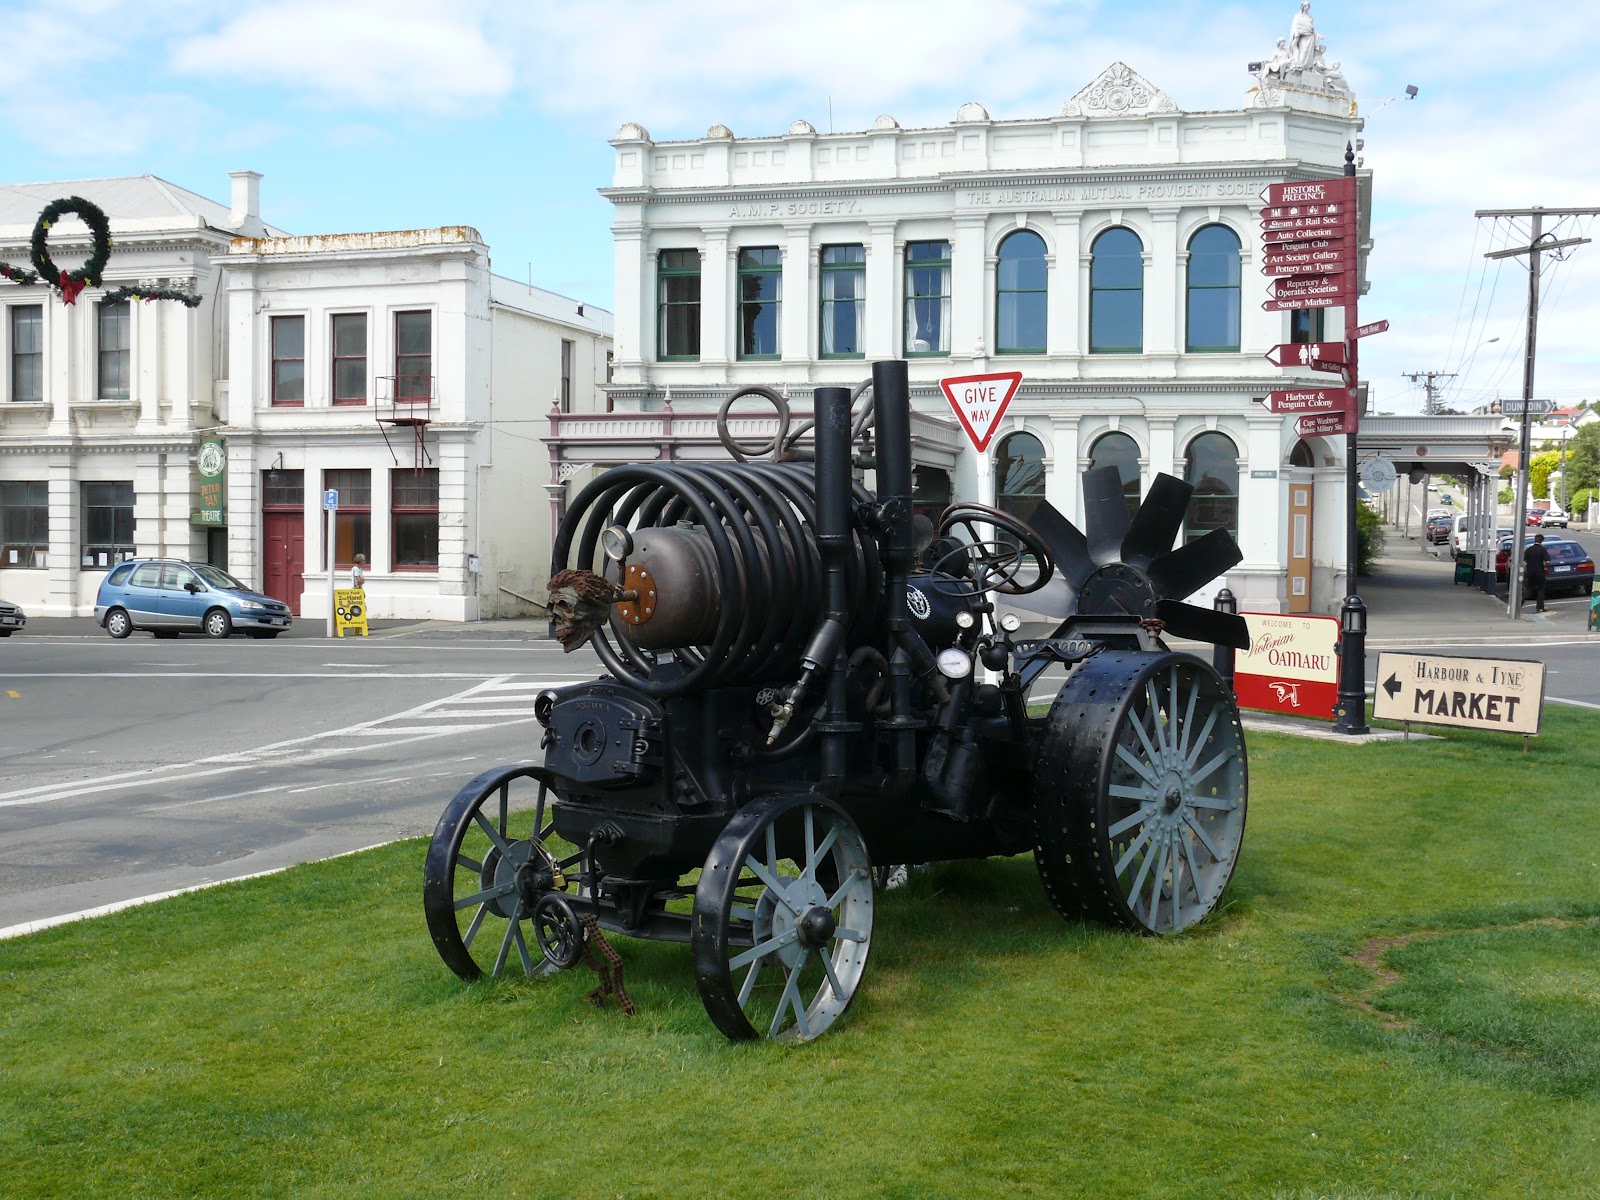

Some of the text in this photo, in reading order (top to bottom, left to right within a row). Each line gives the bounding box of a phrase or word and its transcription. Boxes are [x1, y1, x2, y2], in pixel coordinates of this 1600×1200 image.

[967, 191, 991, 204] THE
[997, 188, 1074, 203] AUSTRALIAN
[1080, 185, 1131, 200] MUTUAL
[1137, 183, 1210, 198] PROVIDENT
[1283, 184, 1325, 195] HISTORIC
[1281, 192, 1326, 202] PRECINCT
[729, 200, 862, 217] A.M.P. SOCIETY.
[1305, 217, 1320, 226] Rail
[1323, 216, 1338, 224] Soc.
[1276, 229, 1332, 240] Auto Collection
[1282, 240, 1329, 251] Penguin Club
[1271, 251, 1338, 263] Art Society Gallery
[1275, 265, 1300, 274] Pottery
[1314, 263, 1334, 271] Tyne
[1287, 277, 1328, 288] Repertory &
[1277, 285, 1338, 298] Operatic Societies
[1277, 298, 1333, 309] Sunday Markets
[964, 386, 997, 404] GIVE
[1285, 391, 1325, 401] Harbour &
[1277, 399, 1333, 410] Penguin Colony
[971, 409, 991, 422] WAY
[1302, 419, 1315, 428] Cape
[1300, 427, 1316, 435] Historic
[1316, 425, 1334, 433] Military
[201, 484, 220, 496] PETER
[201, 510, 221, 522] THEATRE
[1262, 620, 1311, 630] WELCOME TO
[1241, 632, 1296, 659] Victorian
[1268, 648, 1330, 671] OAMARU
[1416, 661, 1522, 686] HARBOUR & TYNE
[1413, 687, 1521, 723] MARKET
